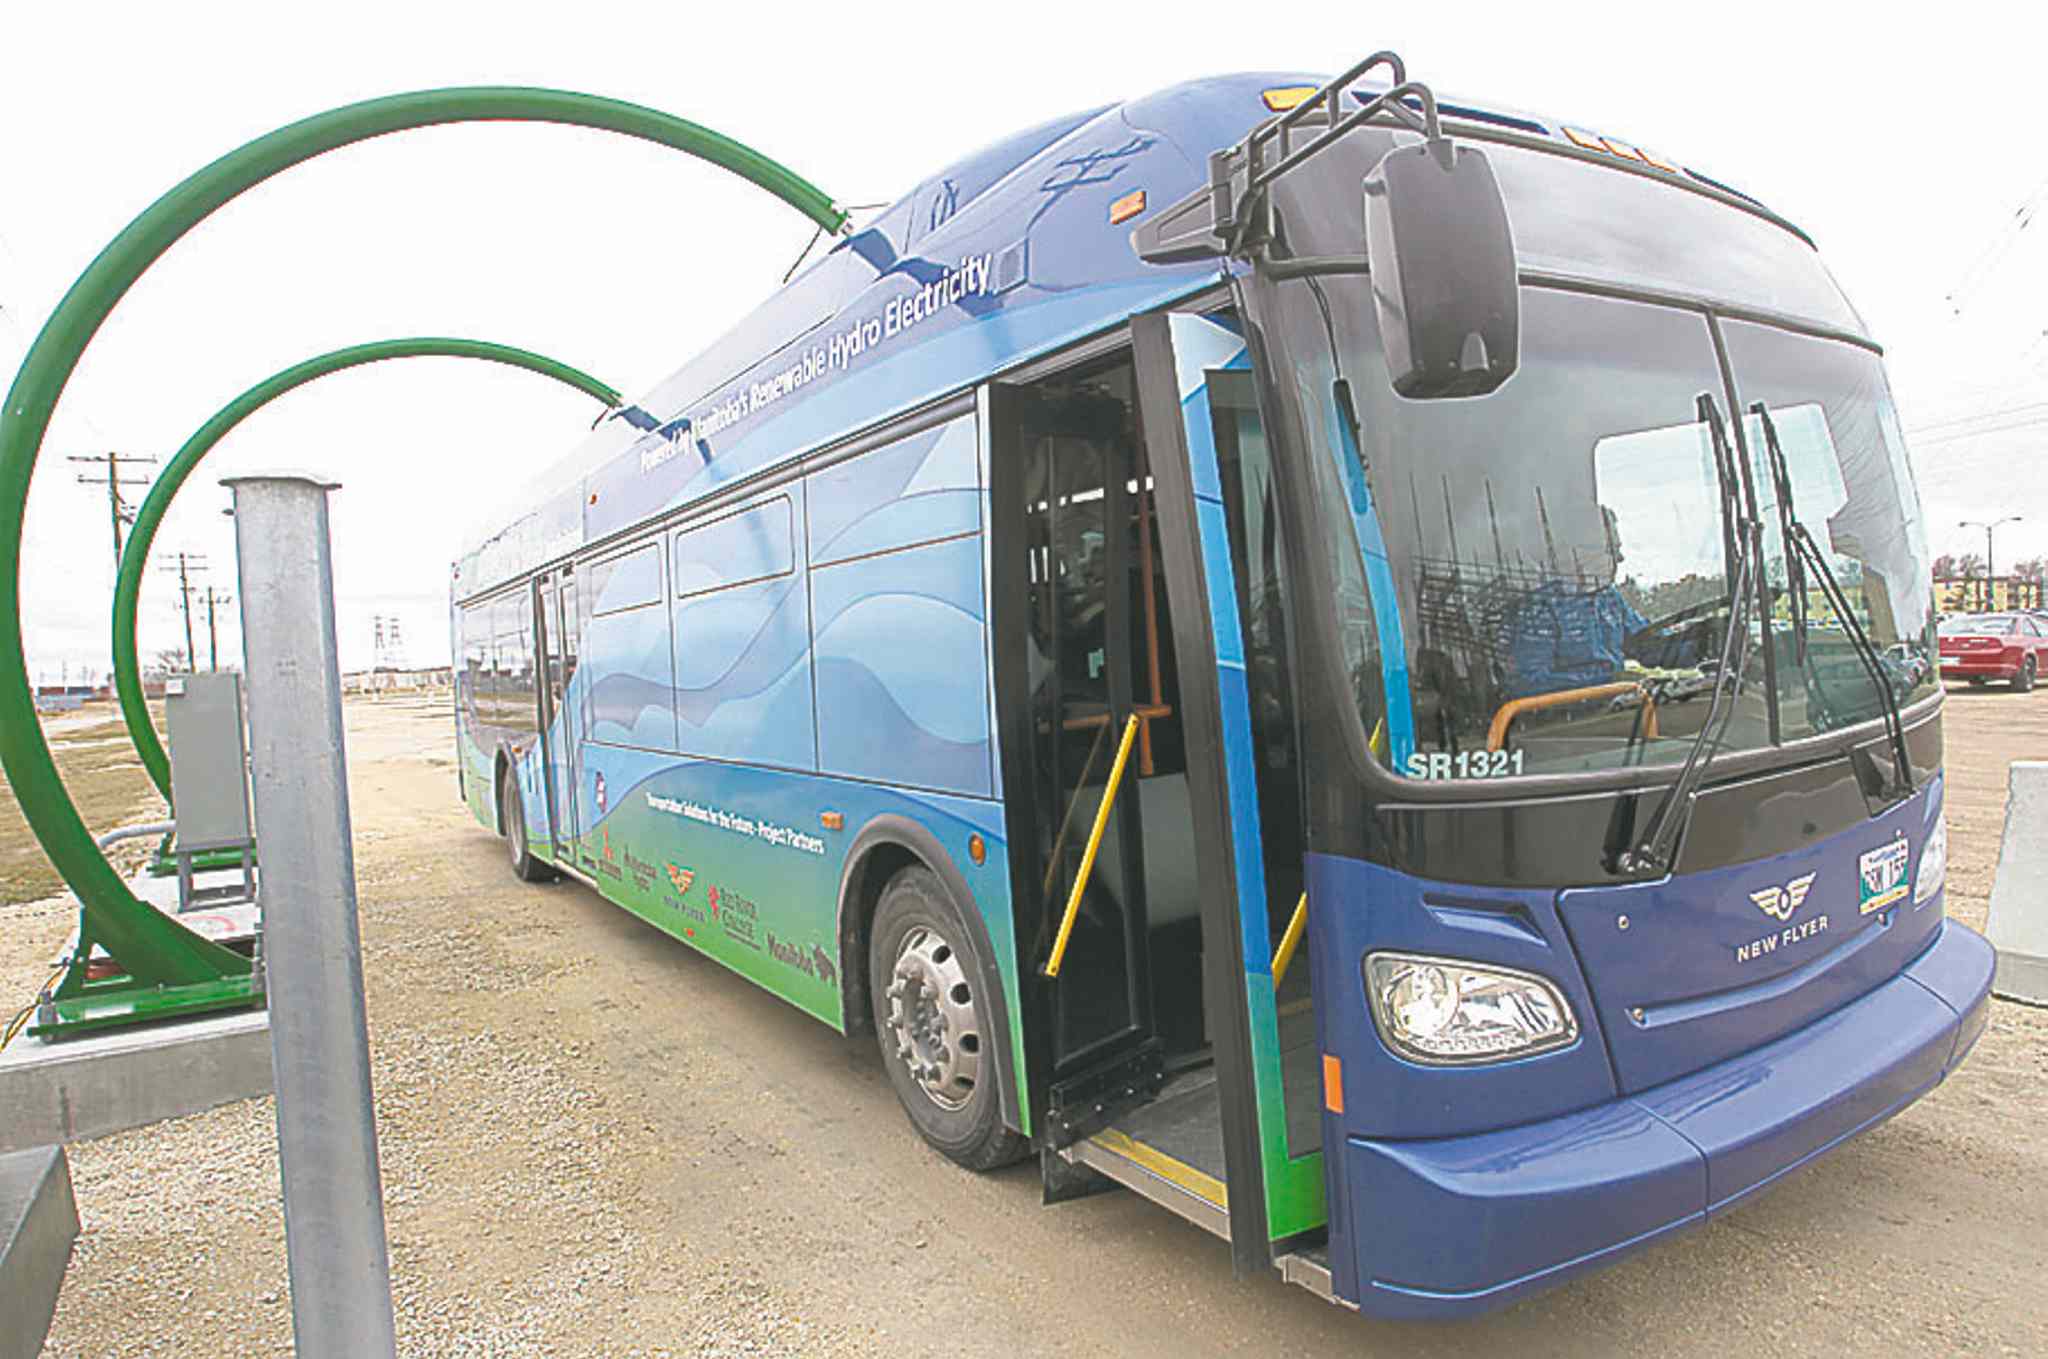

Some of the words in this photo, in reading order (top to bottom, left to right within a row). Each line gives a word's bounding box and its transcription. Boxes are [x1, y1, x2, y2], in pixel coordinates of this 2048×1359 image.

[750, 346, 826, 413] Renewable
[828, 319, 881, 370] Hydro
[884, 252, 993, 338] Electricity
[1406, 749, 1525, 781] SR1321
[1737, 935, 1778, 963] NEW
[1782, 915, 1829, 947] FLYER
